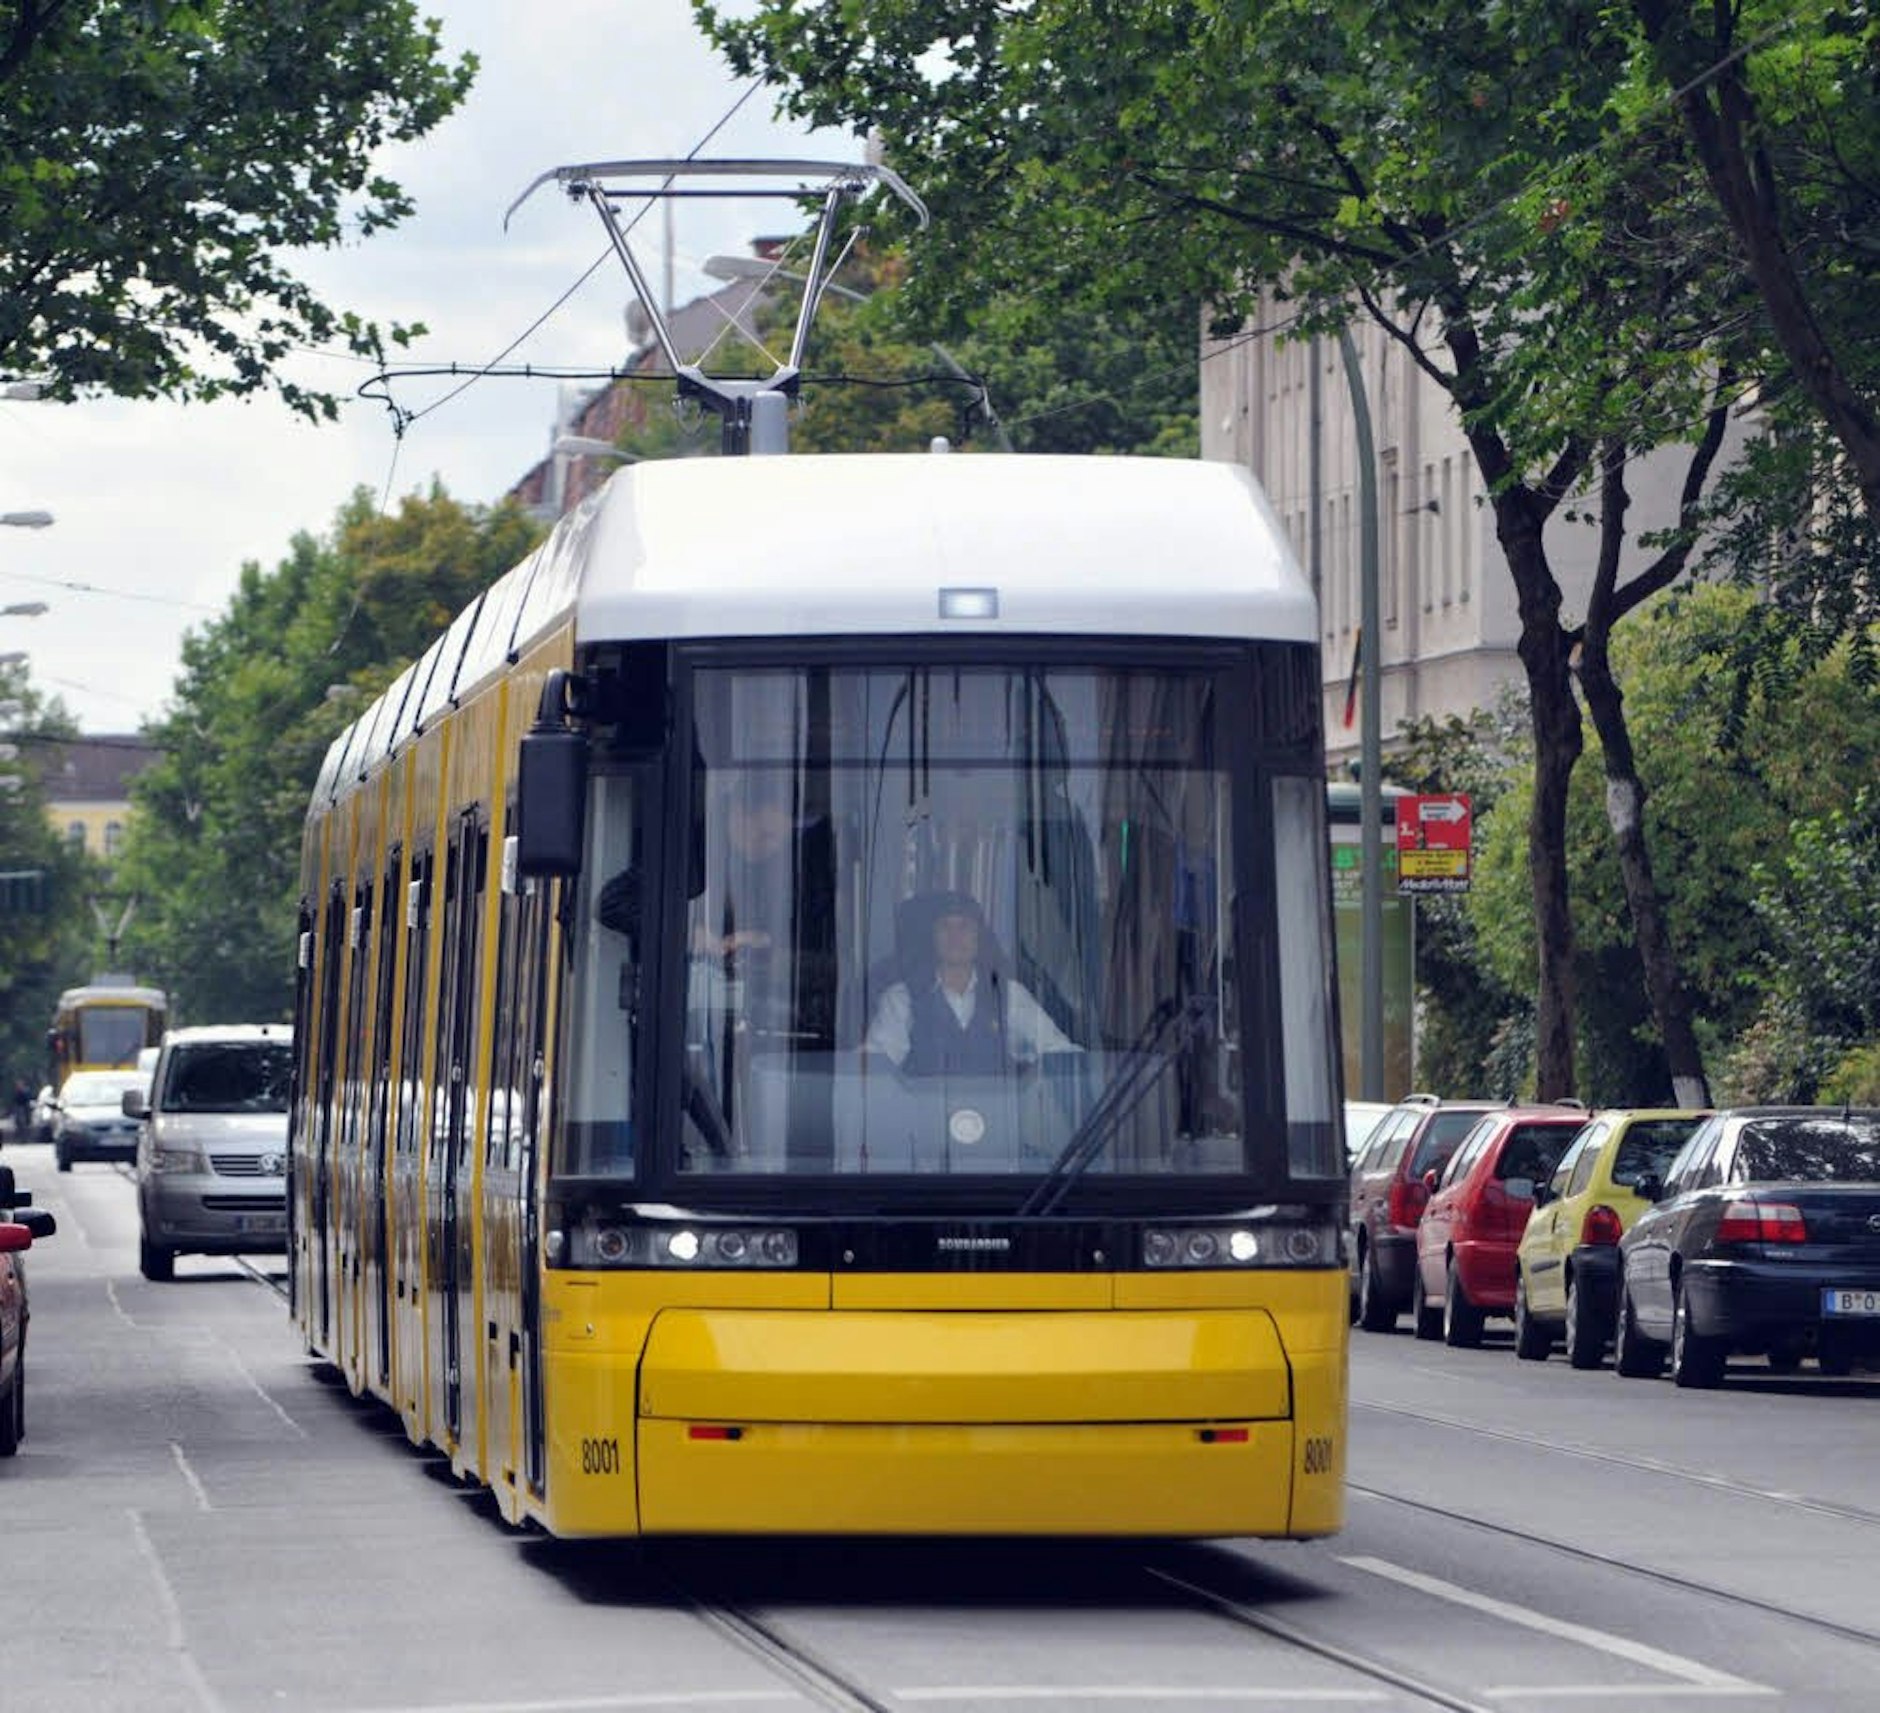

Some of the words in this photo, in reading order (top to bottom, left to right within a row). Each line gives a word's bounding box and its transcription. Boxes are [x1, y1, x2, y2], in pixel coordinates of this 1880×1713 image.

[1842, 1293, 1853, 1310] B
[582, 1437, 620, 1475] 8001
[1304, 1437, 1333, 1475] 8001
